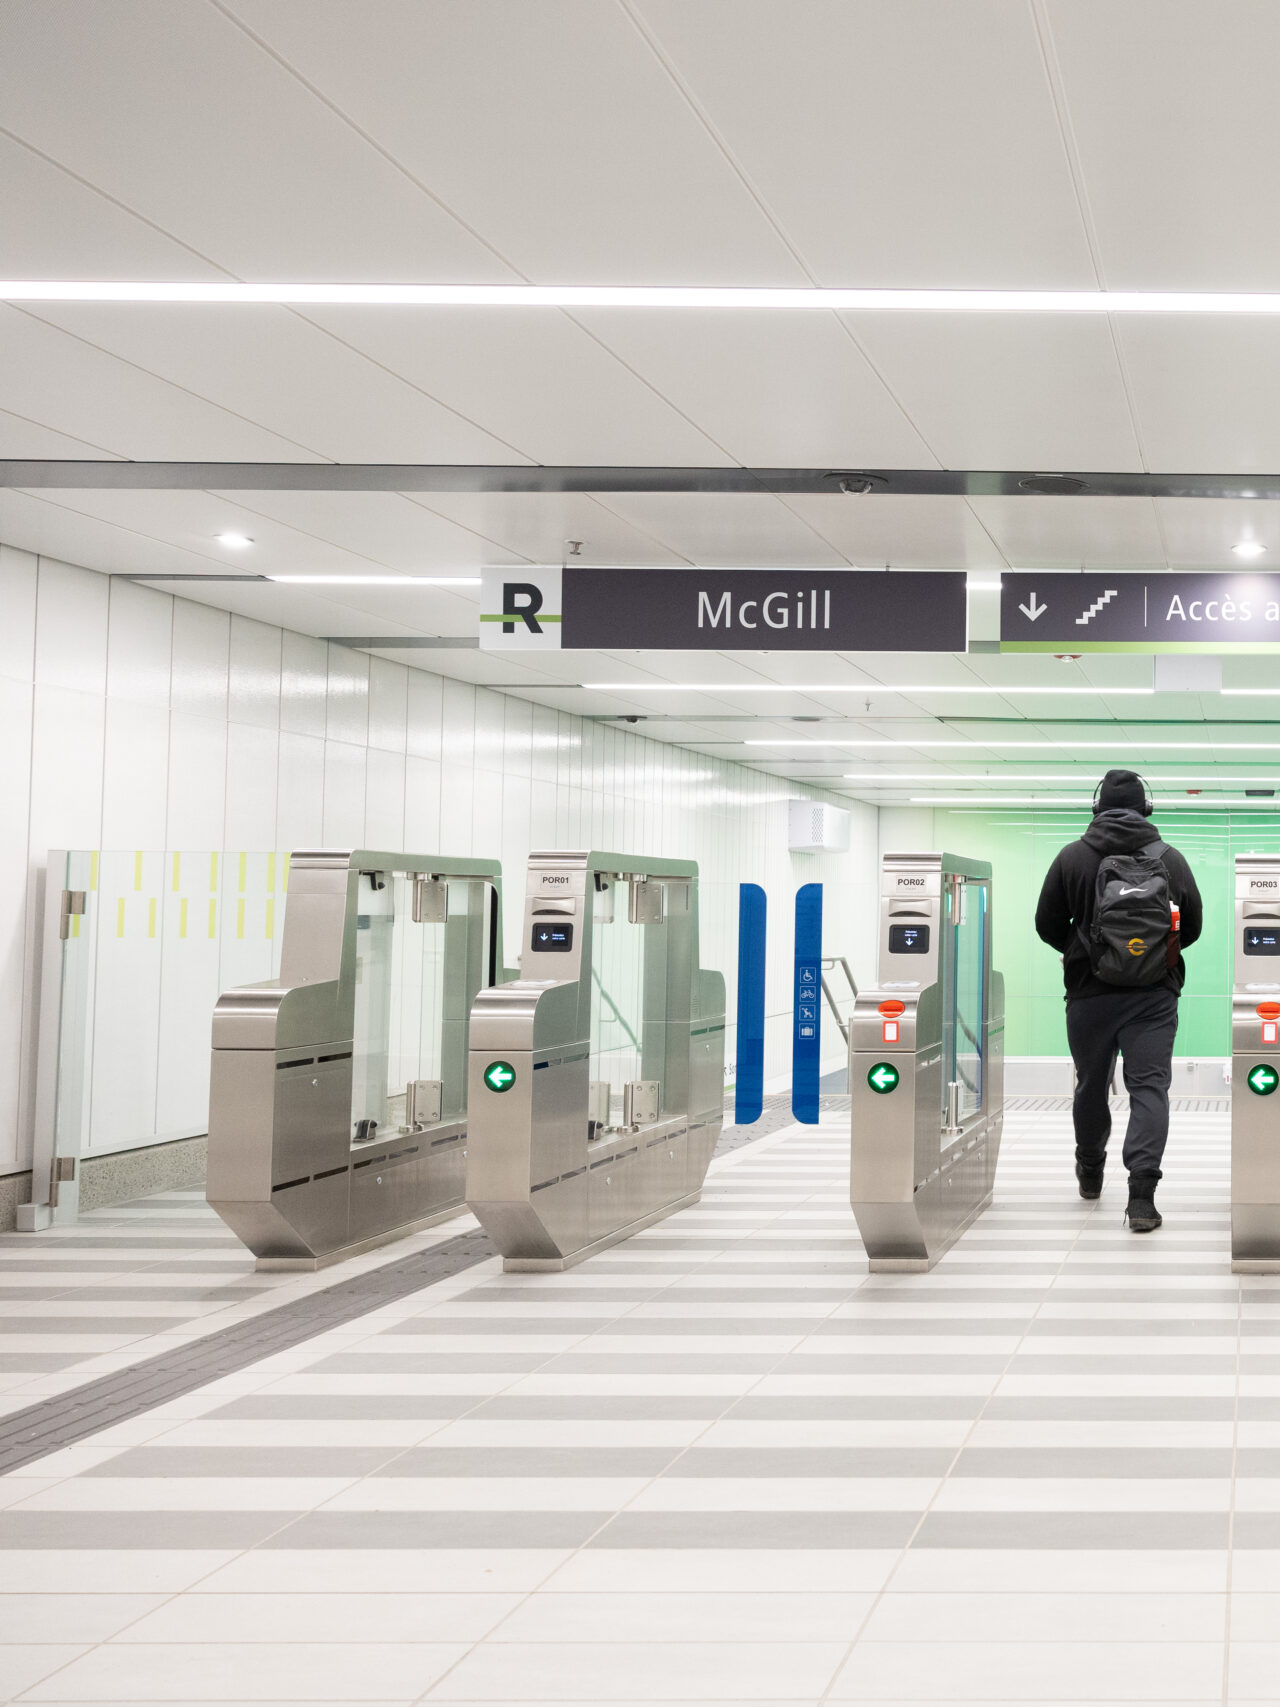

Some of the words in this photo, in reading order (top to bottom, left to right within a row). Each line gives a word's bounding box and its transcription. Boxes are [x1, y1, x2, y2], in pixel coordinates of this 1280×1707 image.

[502, 582, 544, 634] R
[697, 589, 831, 629] McGill
[1165, 593, 1252, 623] Accès
[542, 876, 569, 884] POR01
[897, 878, 925, 886] POR02
[1250, 881, 1278, 889] POR03
